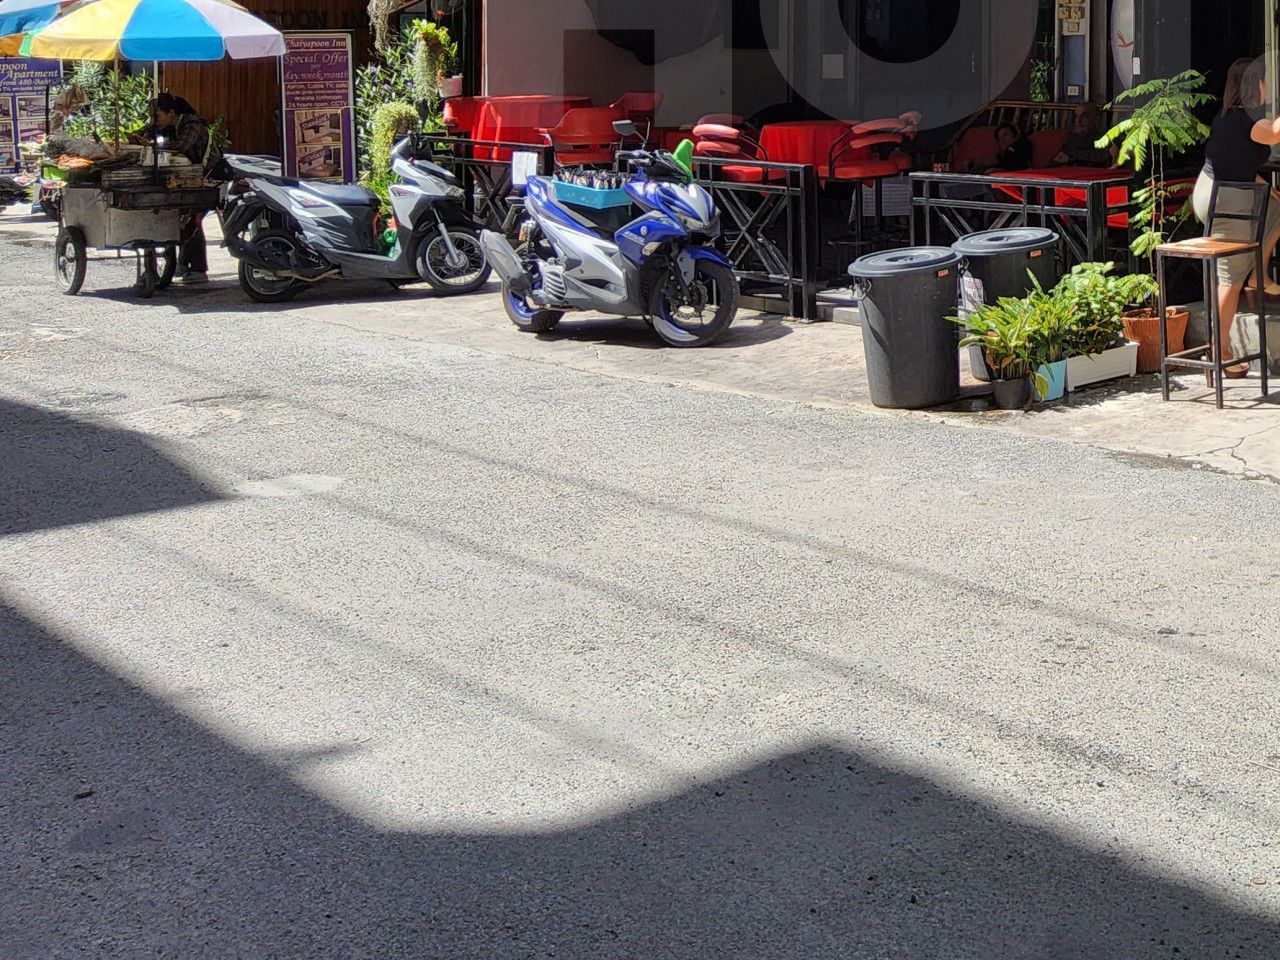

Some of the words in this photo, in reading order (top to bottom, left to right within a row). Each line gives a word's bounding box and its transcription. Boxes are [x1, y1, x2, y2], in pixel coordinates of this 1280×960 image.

[332, 39, 346, 47] Inn
[285, 53, 319, 65] Special
[322, 52, 348, 65] Offer
[3, 70, 59, 81] Apartment
